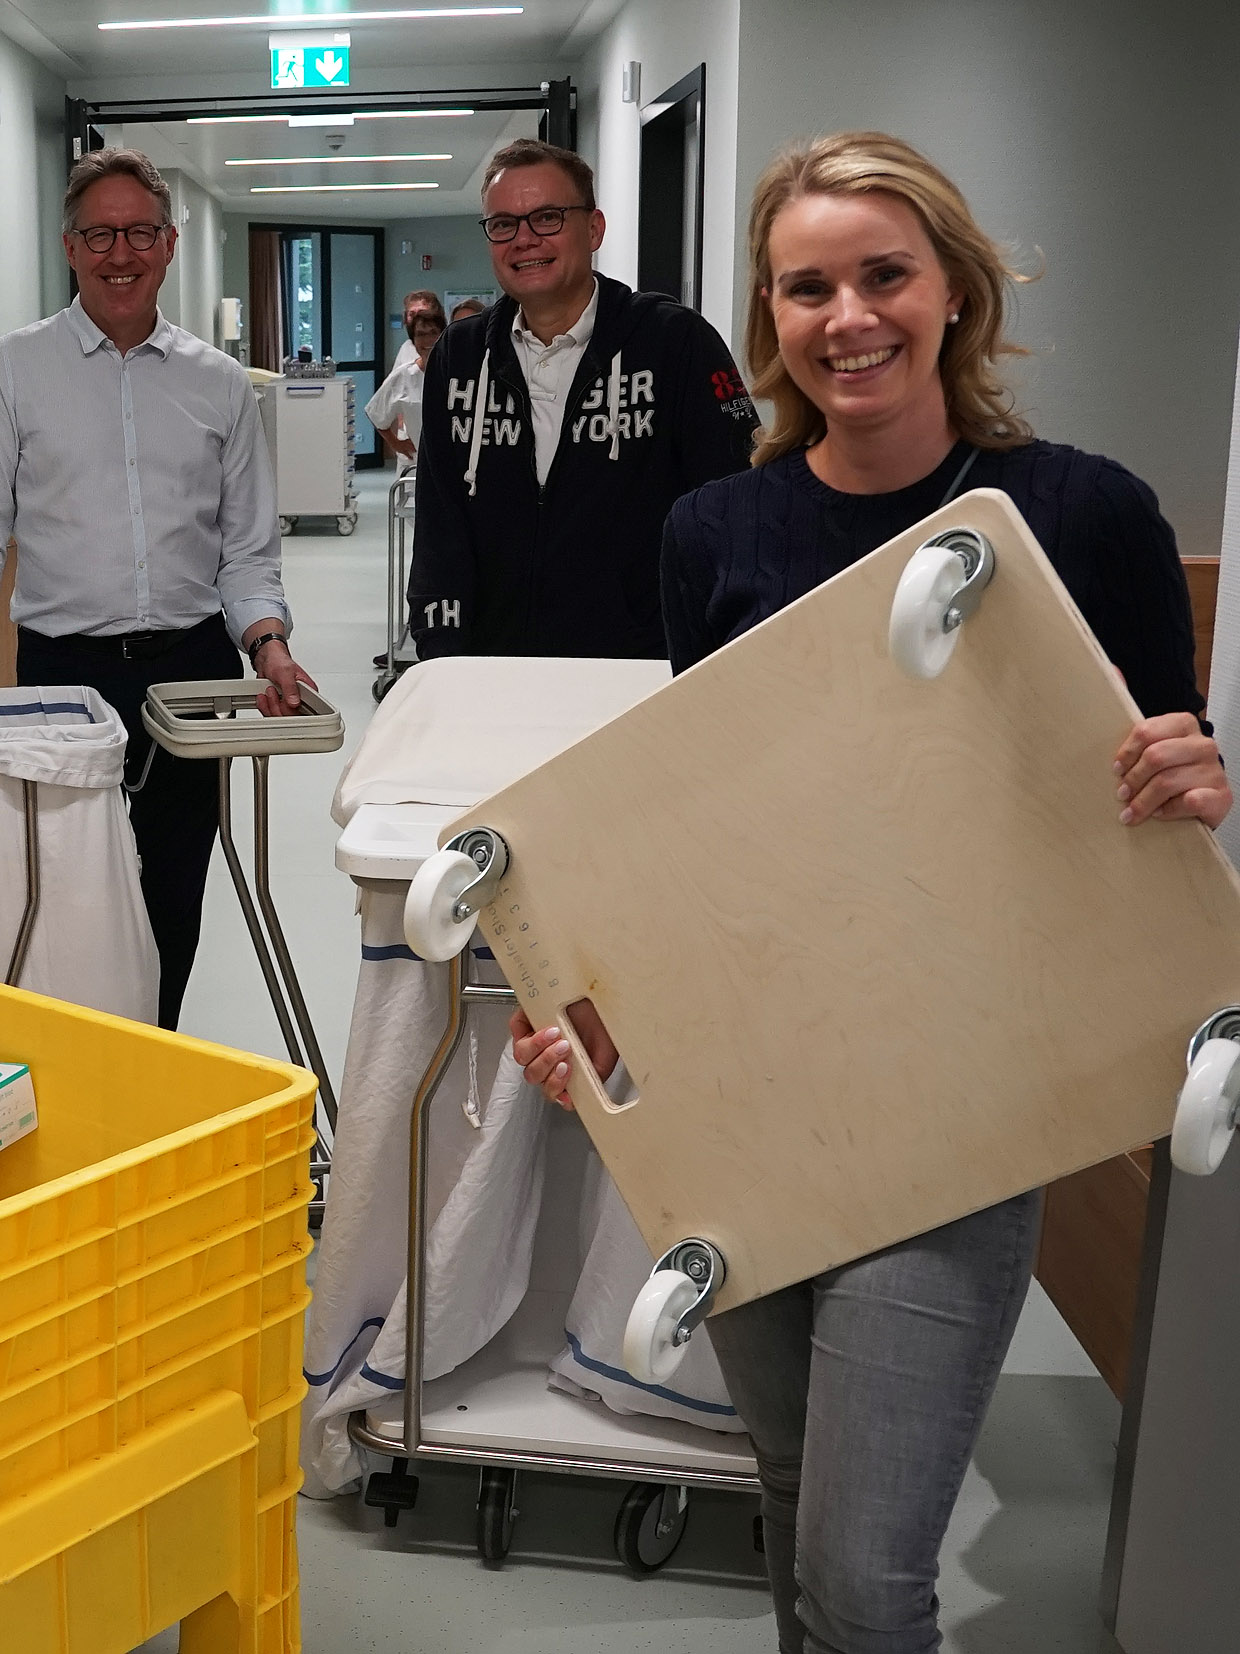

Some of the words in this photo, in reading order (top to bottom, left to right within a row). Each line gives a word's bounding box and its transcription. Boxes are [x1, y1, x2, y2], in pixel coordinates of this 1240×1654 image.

[452, 416, 521, 446] NEW
[572, 409, 655, 443] YORK
[424, 599, 460, 629] TH
